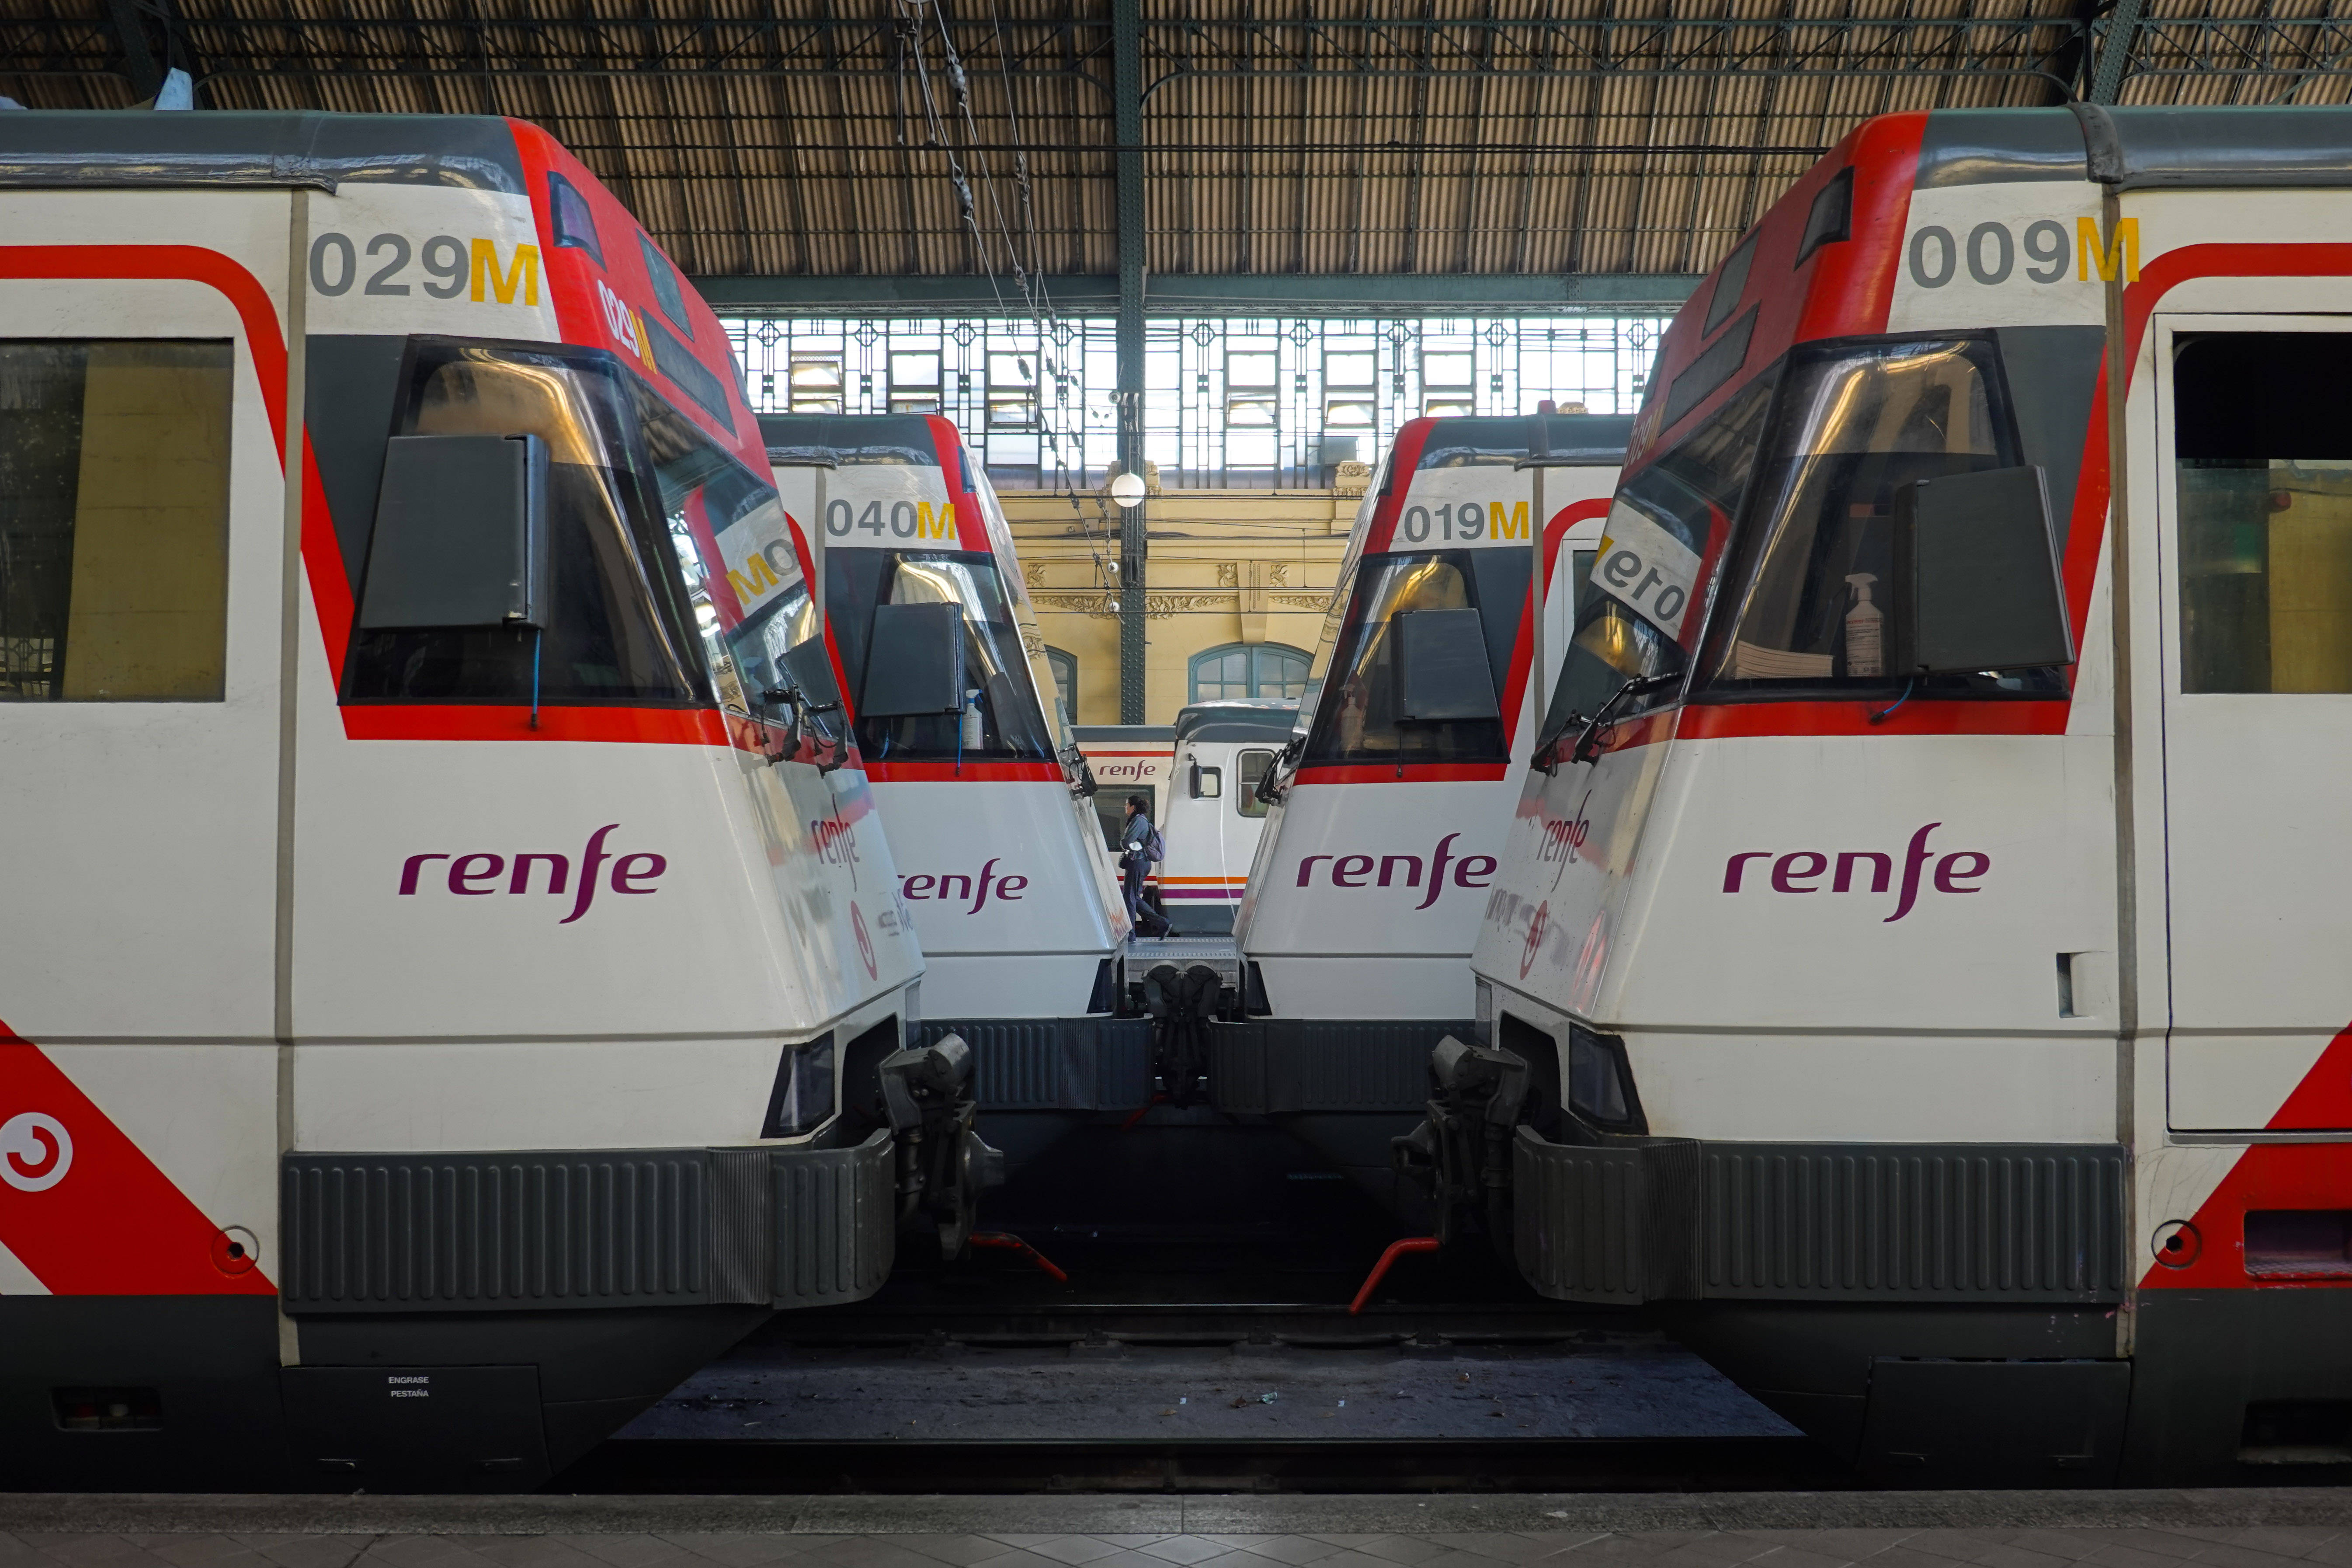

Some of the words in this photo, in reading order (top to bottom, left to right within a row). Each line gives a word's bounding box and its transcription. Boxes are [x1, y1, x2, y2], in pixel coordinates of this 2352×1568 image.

[309, 233, 538, 306] 029M
[1909, 217, 2140, 289] 009M
[598, 279, 657, 375] 029M
[826, 499, 955, 540] 040M
[1404, 501, 1529, 542] 019M
[1099, 760, 1156, 782] renfe
[399, 824, 667, 924] renfe
[811, 793, 860, 892] renfe
[1296, 833, 1497, 910] renfe
[1536, 789, 1592, 893] renfe
[1723, 822, 1990, 922] renfe
[391, 1389, 429, 1397] PESTAÑA
